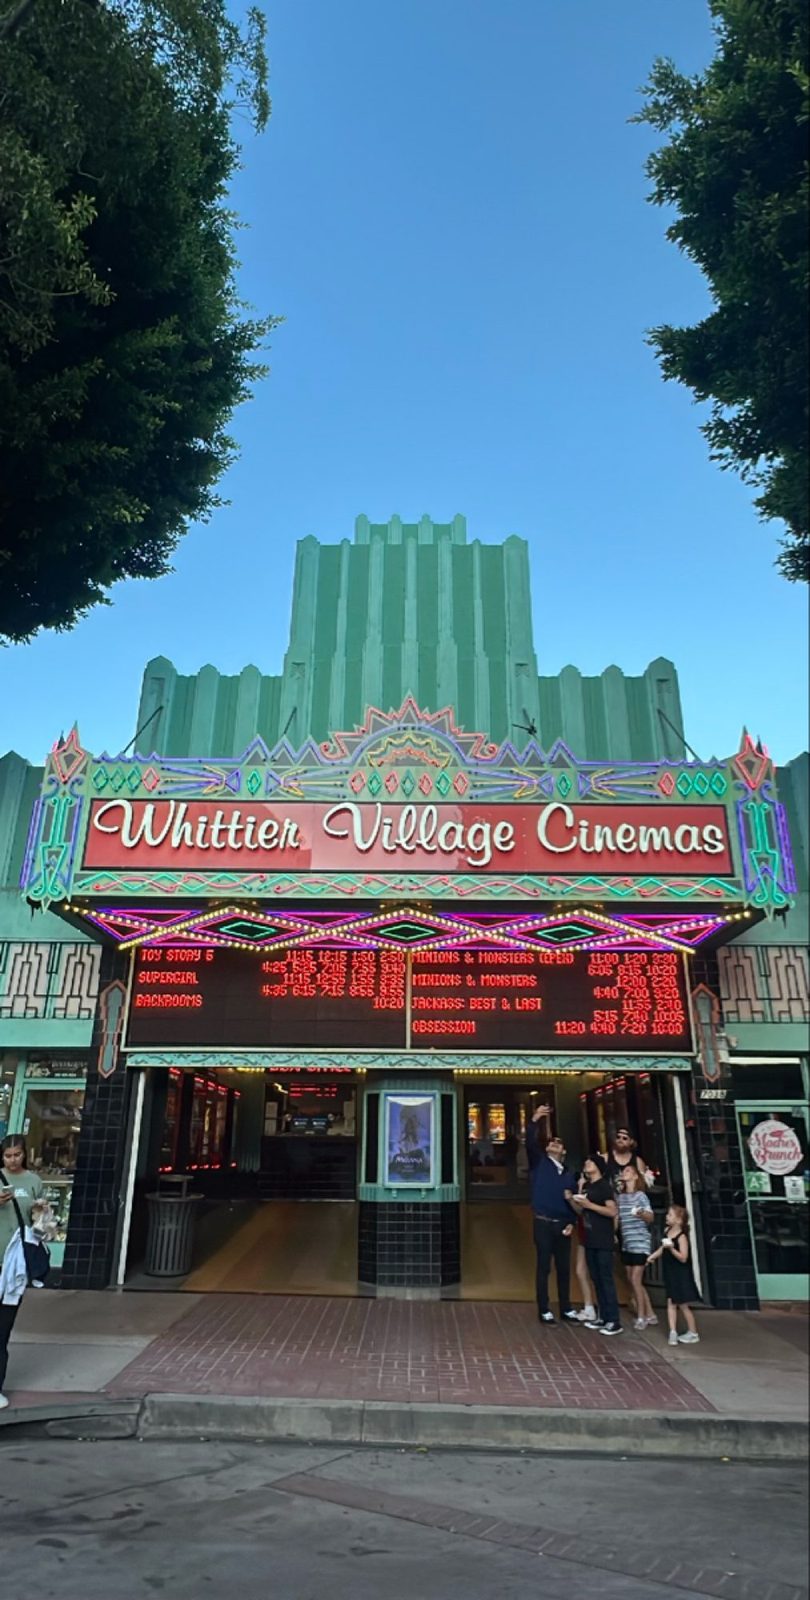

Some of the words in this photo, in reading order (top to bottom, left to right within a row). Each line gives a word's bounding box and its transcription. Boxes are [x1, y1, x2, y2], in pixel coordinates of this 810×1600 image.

[94, 799, 299, 849] Whittier
[323, 802, 516, 867] Village
[537, 802, 725, 853] Cinemas
[142, 949, 162, 961] TOY
[166, 949, 201, 961] STORY
[206, 949, 214, 961] 5
[286, 950, 313, 962] 11:15
[318, 951, 347, 962] 12:15
[352, 951, 375, 962] 1:50
[380, 951, 405, 962] 2:50
[412, 952, 460, 963] MINIONS
[464, 952, 474, 963] &
[479, 952, 535, 964] MONSTERS
[590, 953, 619, 964] 11:00
[624, 953, 647, 964] 1:20
[262, 961, 287, 973] 4:25
[292, 961, 317, 973] 5:25
[321, 962, 347, 973] 7:05
[352, 962, 376, 974] 7:55
[588, 964, 613, 976] 6:05
[646, 965, 677, 976] 10:20
[138, 971, 199, 984] SUPERGIRL
[283, 973, 311, 984] 11:15
[316, 973, 346, 985] 12:55
[352, 974, 375, 985] 1:55
[412, 974, 462, 986] MINIONS
[466, 974, 476, 986] &
[481, 974, 537, 987] MONSTERS
[616, 976, 647, 987] 12:00
[651, 976, 677, 987] 2:20
[262, 984, 287, 996] 4:35
[292, 985, 316, 996] 6:15
[320, 985, 345, 996] 7:15
[349, 985, 375, 997] 8:55
[593, 986, 619, 998] 4:40
[624, 987, 649, 998] 7:00
[134, 994, 203, 1007] BACKROOMS
[373, 996, 405, 1009] 10:20
[469, 997, 496, 1010] BEST
[502, 998, 510, 1010] &
[515, 998, 542, 1010] LAST
[622, 999, 651, 1010] 11:55
[657, 999, 681, 1011] 2:40
[593, 1010, 618, 1022] 5:15
[623, 1010, 648, 1022] 7:40
[654, 1010, 685, 1022] 10:05
[412, 1021, 476, 1033] OBSESSION
[555, 1021, 586, 1034] 11:20
[590, 1022, 616, 1034] 4:40
[621, 1021, 647, 1034] 7:20
[651, 1022, 683, 1034] 10:00
[753, 1146, 801, 1165] Brunch
